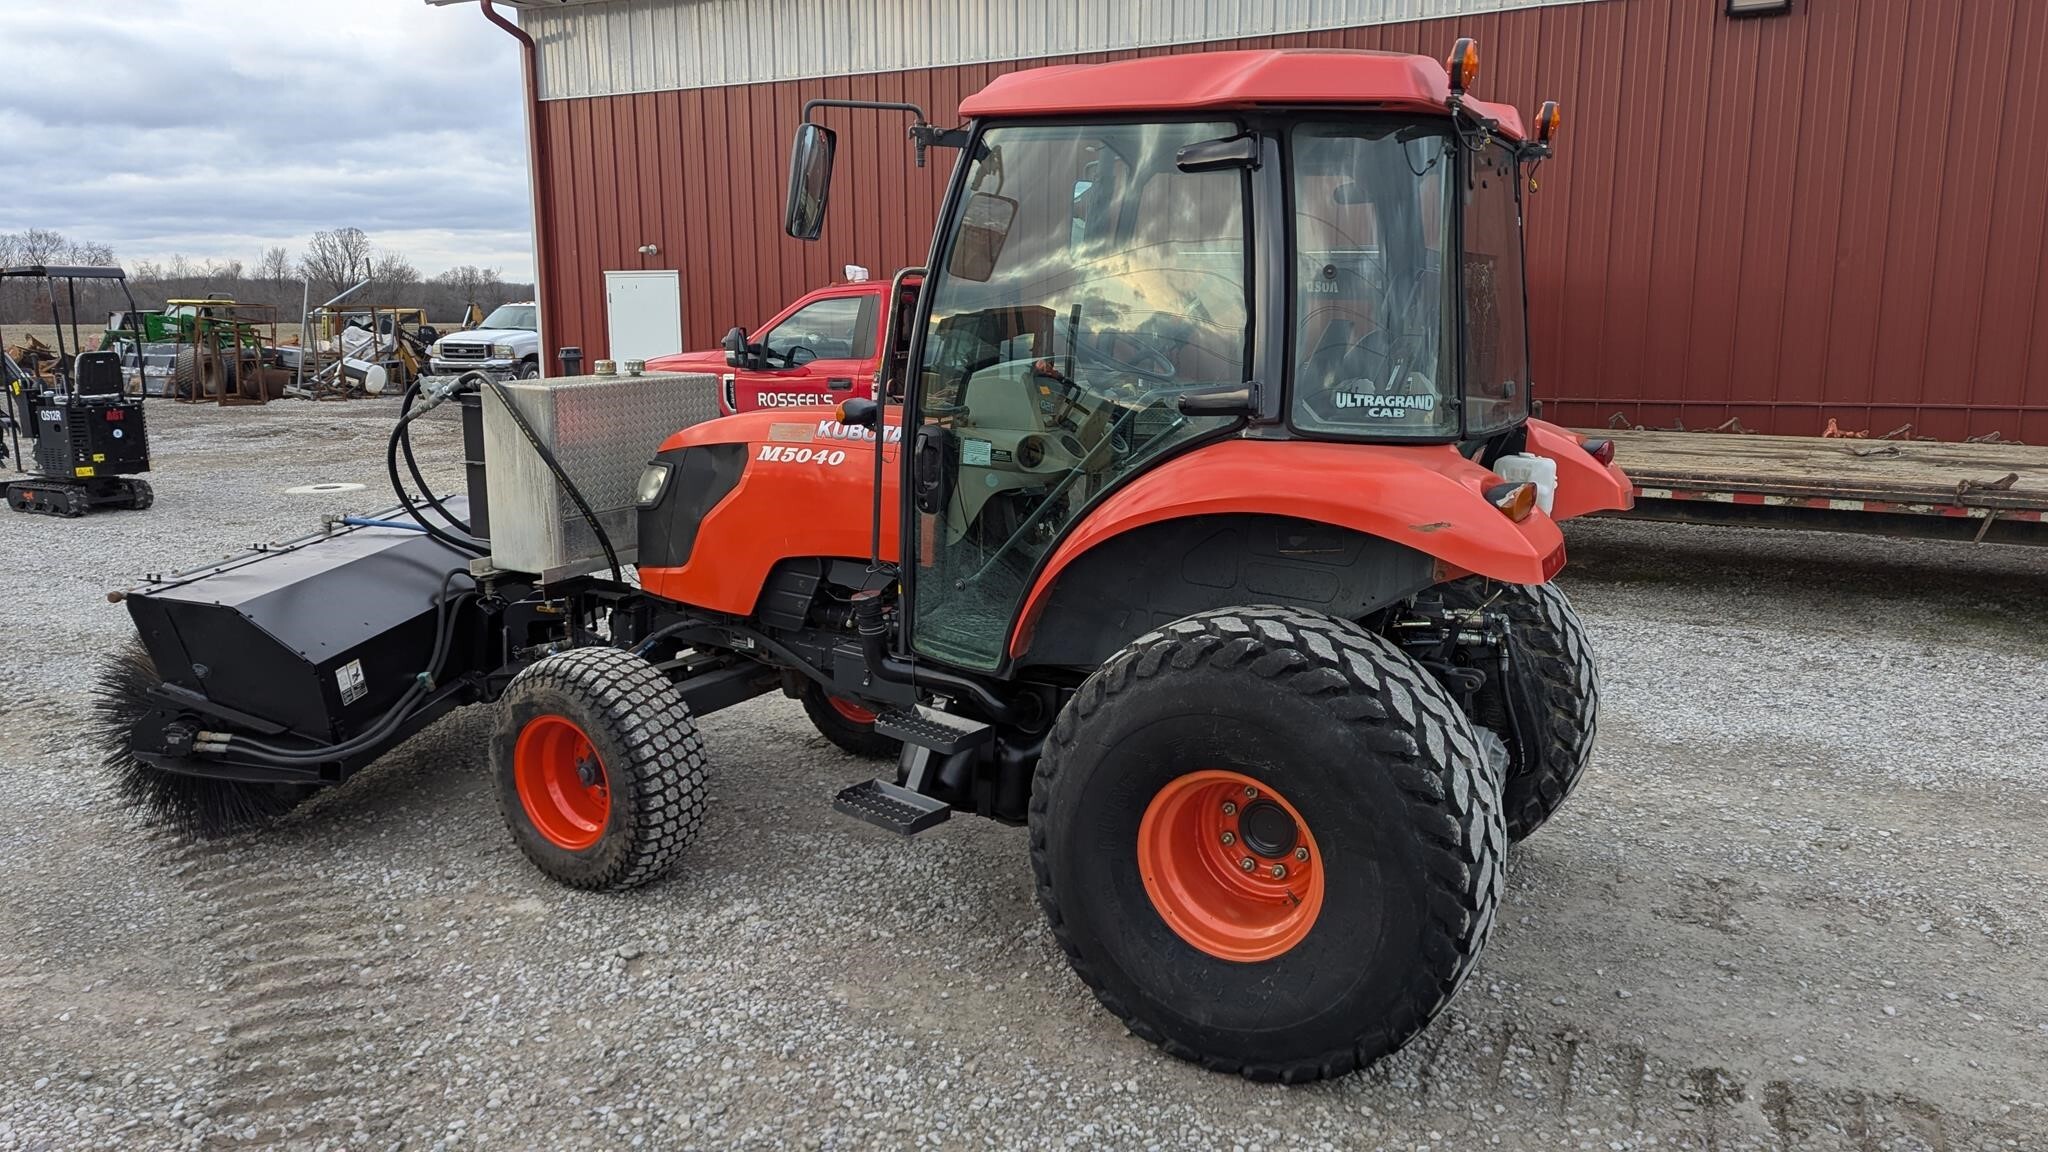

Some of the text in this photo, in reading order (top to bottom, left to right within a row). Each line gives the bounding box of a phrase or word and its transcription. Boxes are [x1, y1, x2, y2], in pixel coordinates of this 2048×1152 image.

[1336, 392, 1434, 411] ULTRAGRAND
[1368, 407, 1405, 418] CAB
[756, 445, 845, 466] M5040
